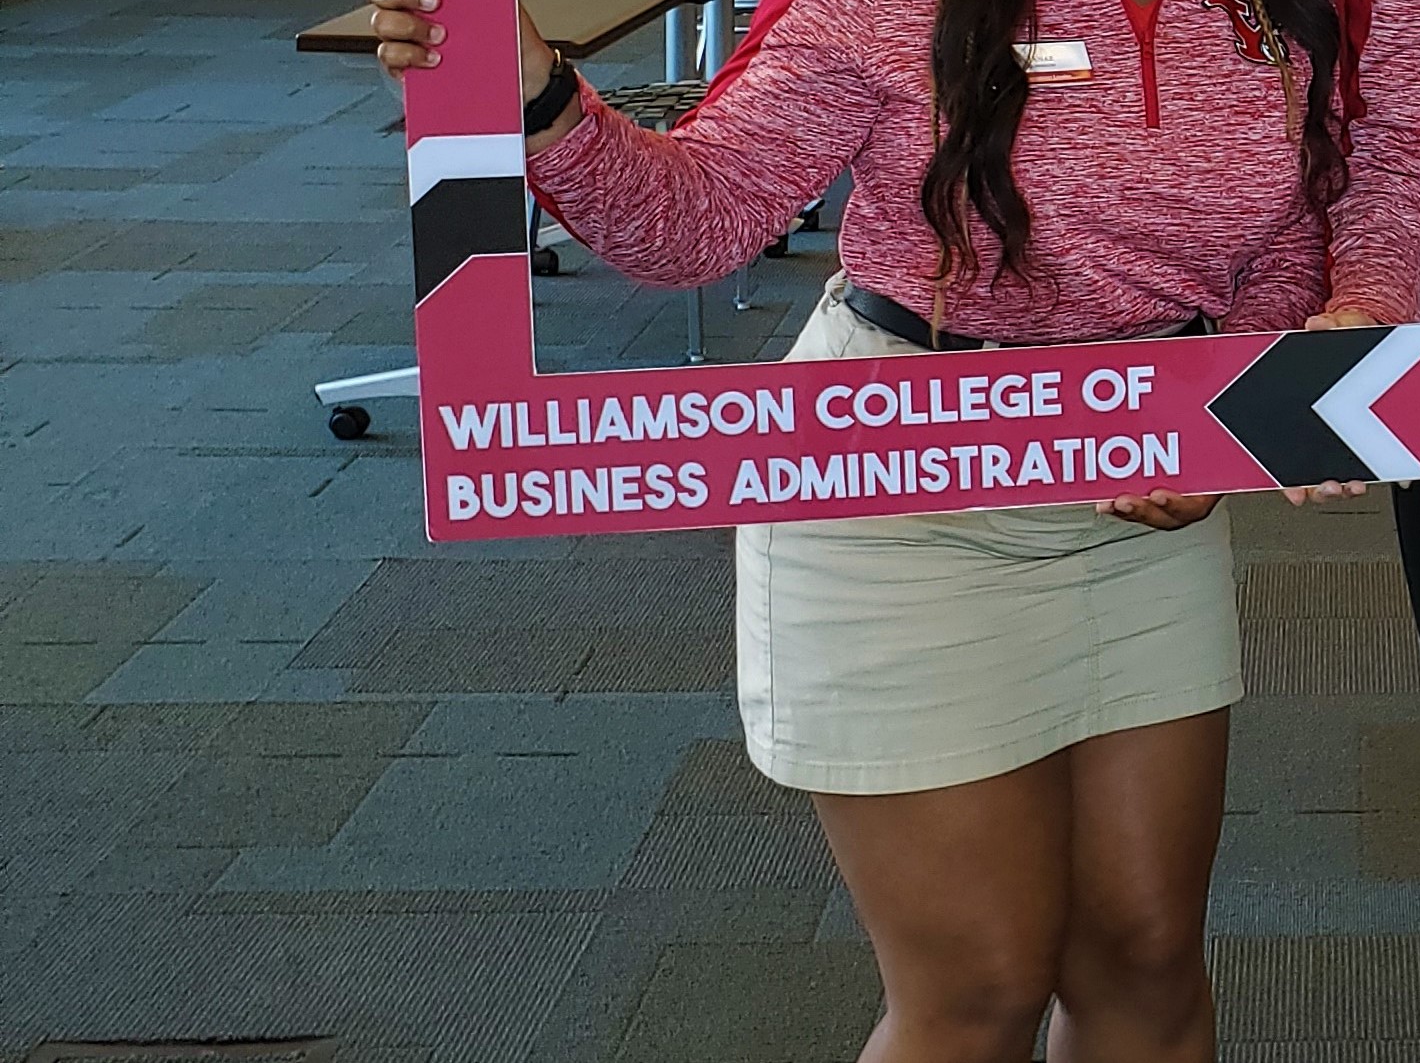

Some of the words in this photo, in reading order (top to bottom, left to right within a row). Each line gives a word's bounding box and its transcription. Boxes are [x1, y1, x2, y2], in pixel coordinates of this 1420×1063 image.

[439, 387, 796, 452] WILLIAMSON
[815, 371, 1063, 429] COLLEGE
[1081, 365, 1157, 413] OF
[446, 461, 709, 521] BUSINESS
[729, 431, 1181, 506] ADMINISTRATION
